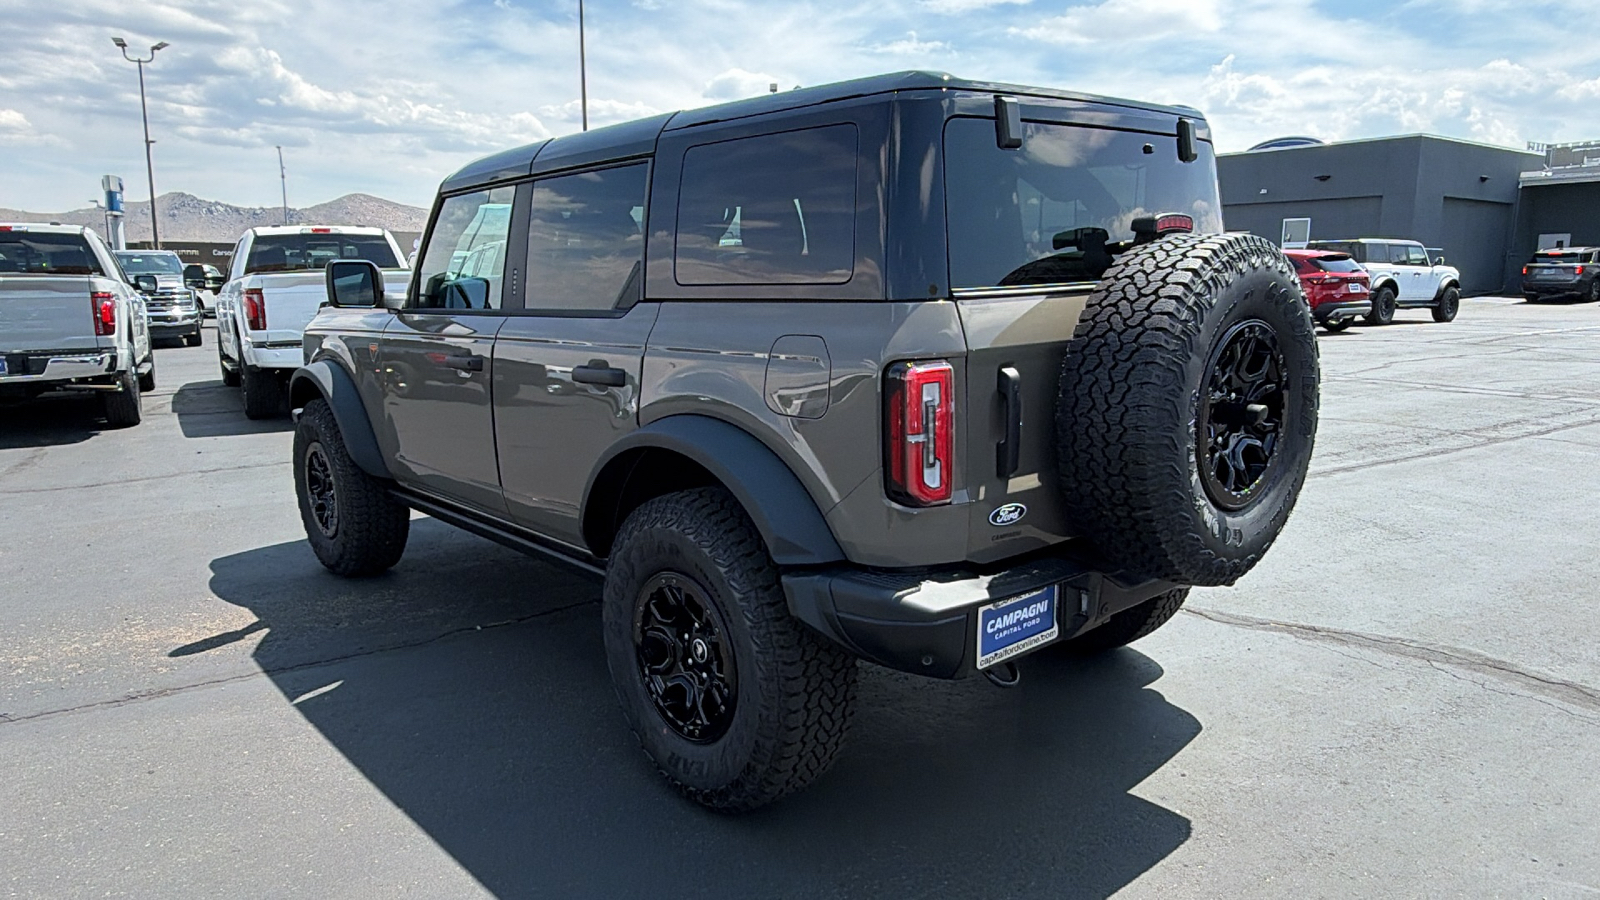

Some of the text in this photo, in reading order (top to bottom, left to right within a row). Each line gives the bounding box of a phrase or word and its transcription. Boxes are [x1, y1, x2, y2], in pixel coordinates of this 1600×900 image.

[212, 248, 234, 256] Carso
[996, 505, 1021, 523] Ford
[986, 600, 1048, 633] CAMPAGNI
[994, 617, 1040, 640] CAPITAL FORD
[979, 630, 1056, 667] capitalfordonline.com
